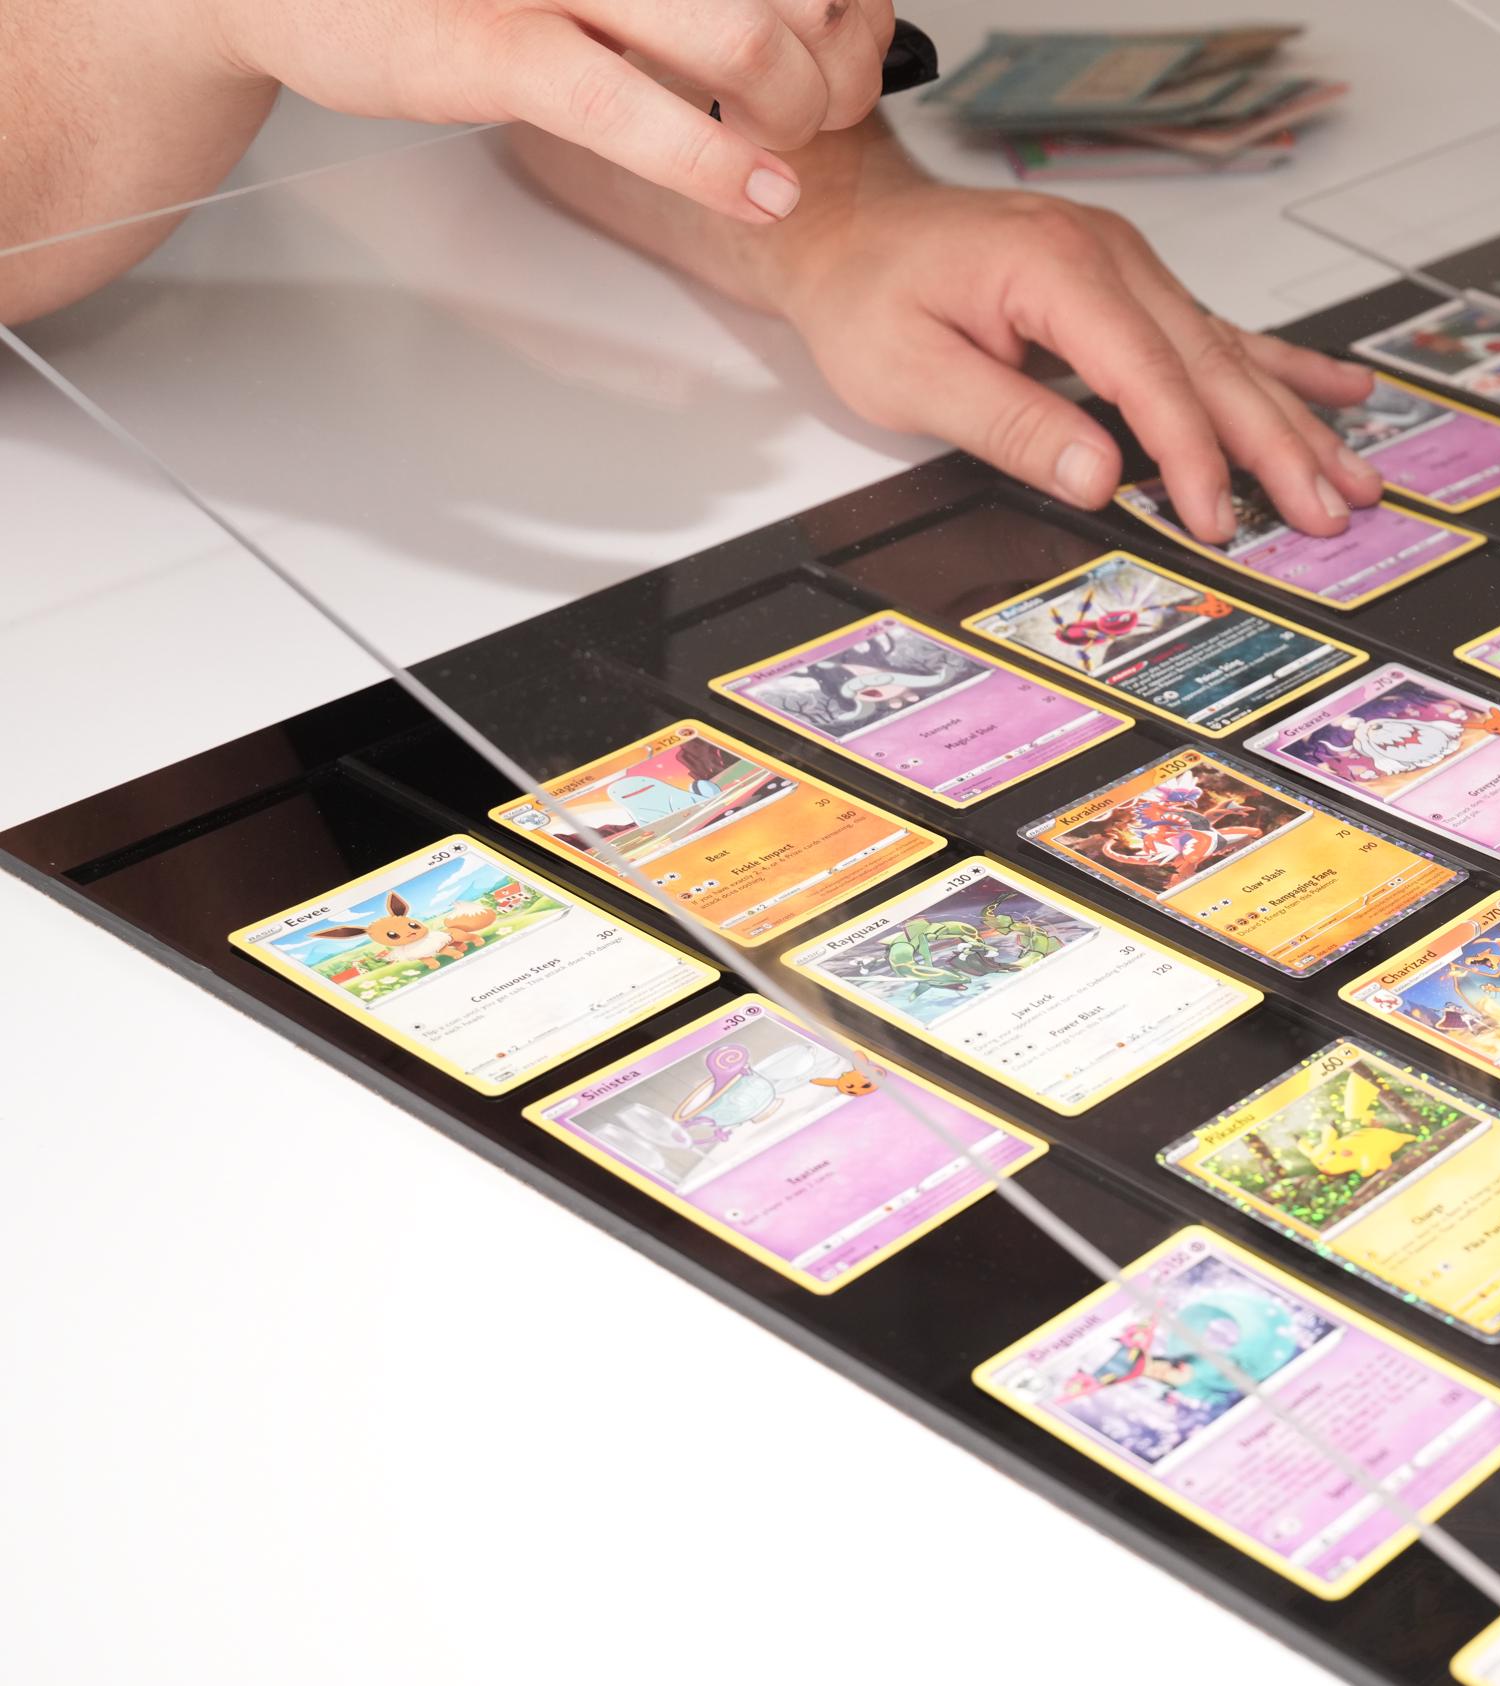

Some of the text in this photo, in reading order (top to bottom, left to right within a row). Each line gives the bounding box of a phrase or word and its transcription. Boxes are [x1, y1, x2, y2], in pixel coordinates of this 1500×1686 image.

[1283, 711, 1330, 736] Greavard
[656, 735, 682, 746] 120
[1158, 760, 1188, 774] 130
[814, 798, 831, 806] 30
[836, 810, 857, 821] 180
[1060, 799, 1113, 825] Koraidon
[1334, 830, 1352, 838] 70
[704, 849, 730, 862] Beat
[1358, 842, 1378, 852] 190
[430, 850, 452, 862] 50
[730, 843, 794, 875] Fickle Impact
[946, 873, 972, 888] 130
[1241, 868, 1286, 892] Claw Slash
[1269, 868, 1338, 906] Rampaging Fang
[284, 907, 329, 926] Eevee
[827, 919, 889, 949] Rayquaza
[1118, 946, 1136, 955] 30
[1152, 964, 1173, 976] 120
[1381, 950, 1437, 984] Charizard
[471, 958, 561, 1002] Continuous Steps
[1011, 993, 1055, 1019] Jaw Lock
[724, 1014, 746, 1026] 30
[1048, 1005, 1104, 1036] Power Blast
[1320, 1056, 1344, 1072] 60
[581, 1071, 640, 1100] Sinistea
[1205, 1115, 1255, 1144] Pikachu
